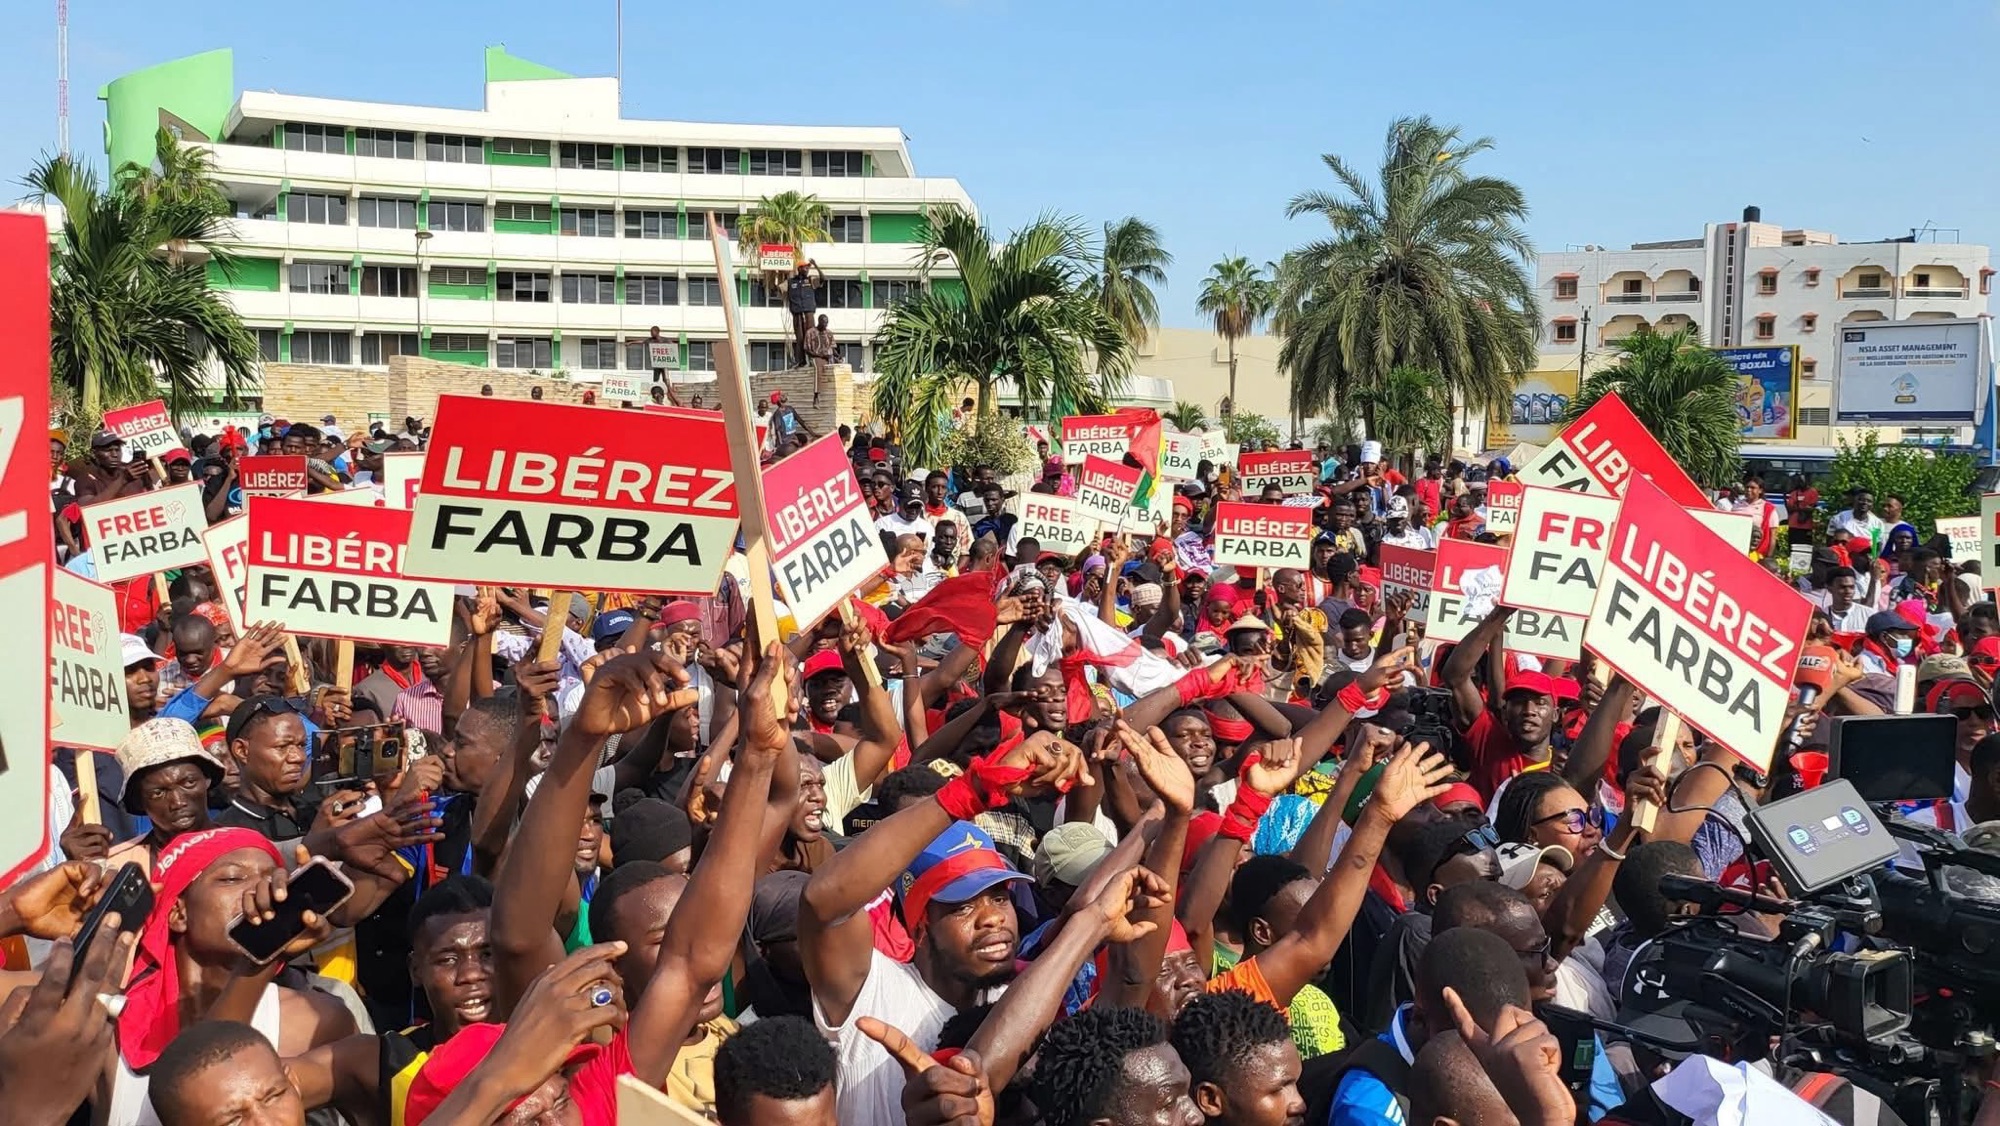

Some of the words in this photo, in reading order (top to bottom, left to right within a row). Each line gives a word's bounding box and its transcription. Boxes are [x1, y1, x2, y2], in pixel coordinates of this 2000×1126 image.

[652, 347, 669, 355] FREE
[1902, 343, 1957, 352] MANAGEMENT
[1739, 360, 1776, 371] SOXALI
[605, 387, 637, 396] FARBA
[606, 379, 629, 388] FREE
[127, 430, 174, 453] ARBA
[1067, 425, 1128, 440] LIBÉREZ
[1068, 441, 1124, 456] FARBA
[245, 468, 306, 488] LIBÉREZ
[443, 445, 737, 511] LIBÉREZ
[1245, 460, 1311, 475] LIBÉREZ
[1026, 503, 1071, 524] FREE
[1080, 489, 1131, 519] FARBA
[97, 505, 167, 540] FREE
[1221, 517, 1309, 538] LIBÉREZ
[1945, 526, 1977, 538] FREE
[431, 504, 702, 567] FARBA
[1023, 522, 1087, 545] FARBA
[103, 526, 202, 565] FARBA
[1221, 538, 1303, 559] FARBA
[783, 517, 873, 603] FARBA
[1383, 562, 1433, 587] LIBÉREZ
[261, 573, 438, 623] FARBA
[1620, 522, 1796, 681] LIBÉREZ
[1605, 578, 1762, 734] FARBA
